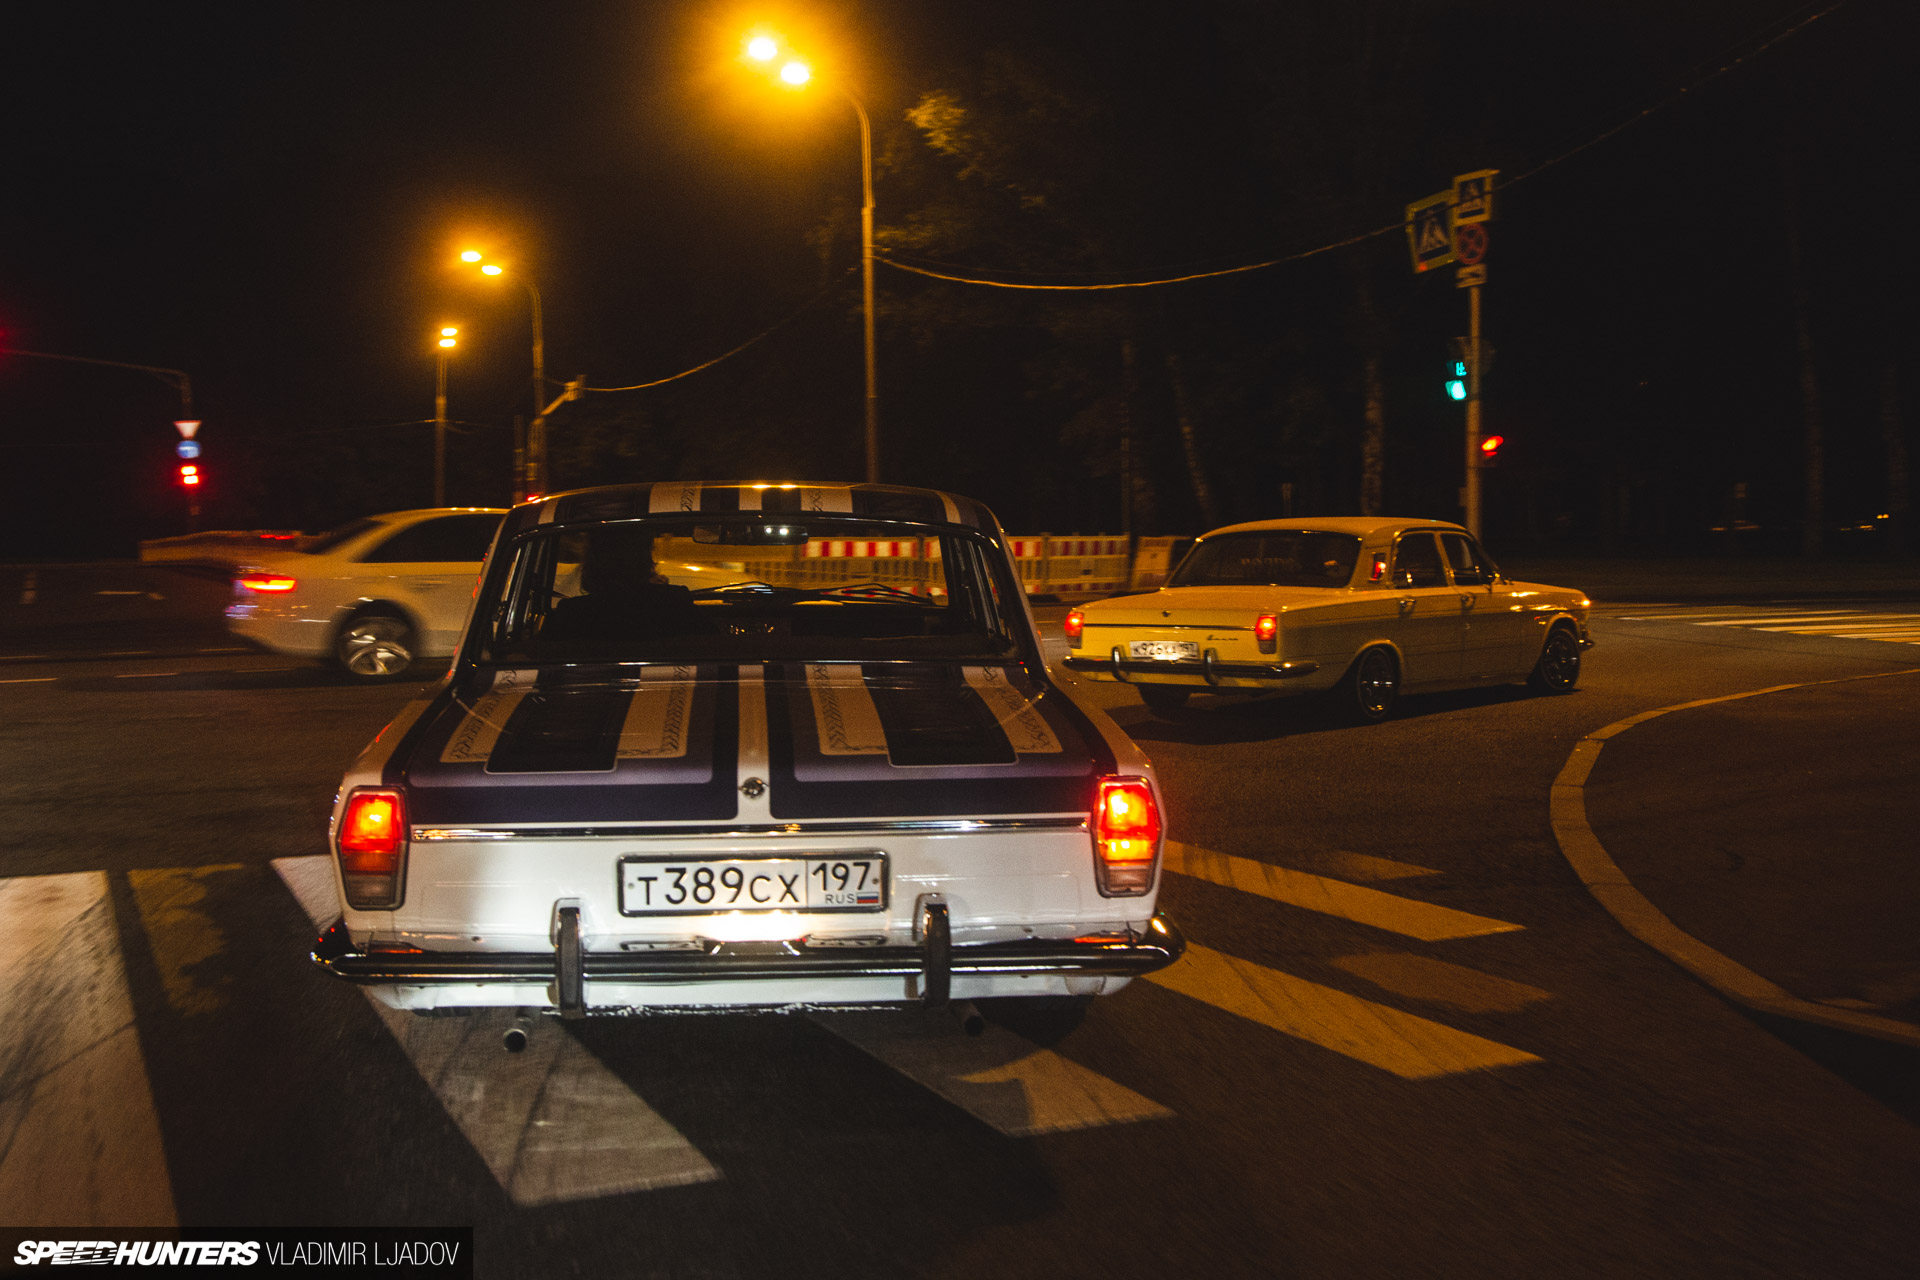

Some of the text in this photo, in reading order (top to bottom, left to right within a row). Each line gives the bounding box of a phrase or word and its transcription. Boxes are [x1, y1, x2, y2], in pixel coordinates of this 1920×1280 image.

[637, 861, 871, 906] T389CX 197
[824, 892, 855, 905] RUS
